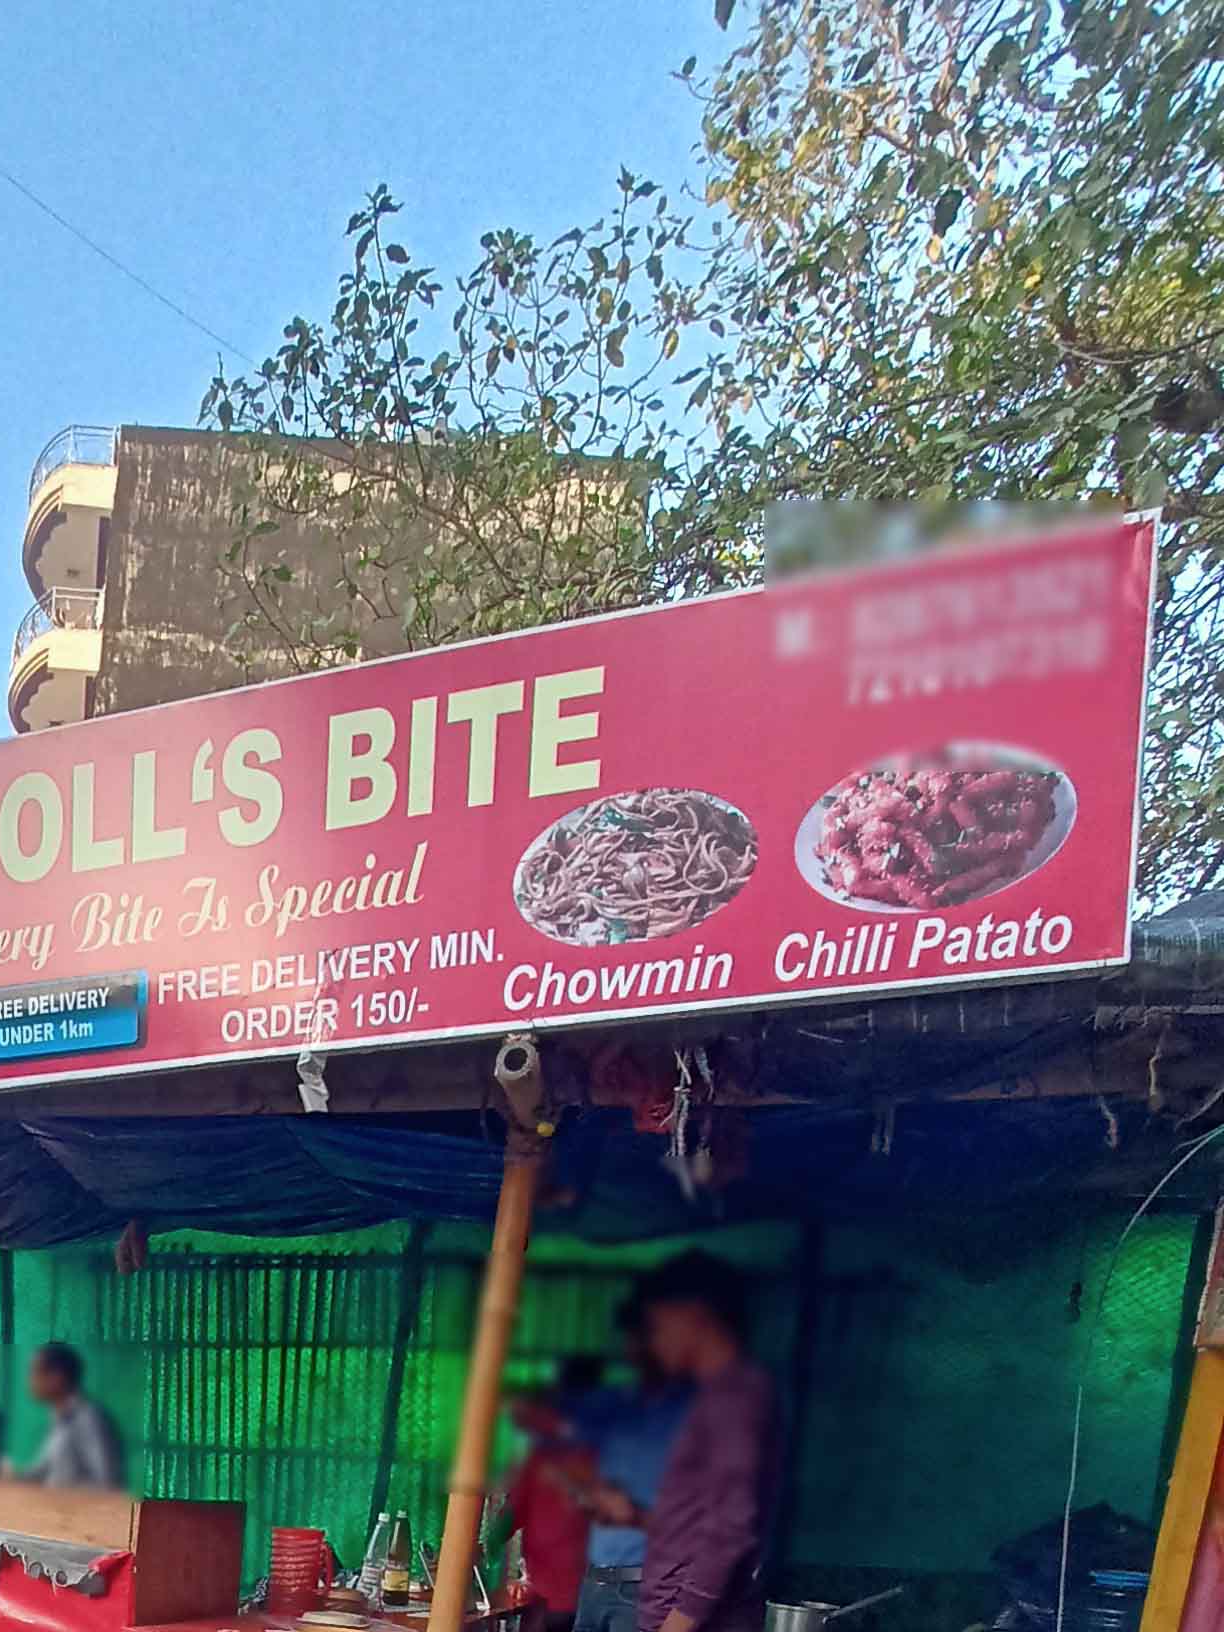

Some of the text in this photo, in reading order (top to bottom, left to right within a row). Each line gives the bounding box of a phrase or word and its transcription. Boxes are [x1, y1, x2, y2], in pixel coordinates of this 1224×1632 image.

[325, 665, 605, 831] BITE
[71, 891, 163, 952] Bite
[177, 876, 229, 936] Is
[244, 841, 426, 937] Special
[158, 928, 504, 1004] FREE DELIVERY MIN.
[503, 945, 734, 1011] Chowmin
[774, 905, 1073, 983] Chilli Patato
[28, 987, 110, 1015] DELIVERY
[59, 1019, 94, 1040] 1km
[221, 987, 430, 1043] ORDER 150/-
